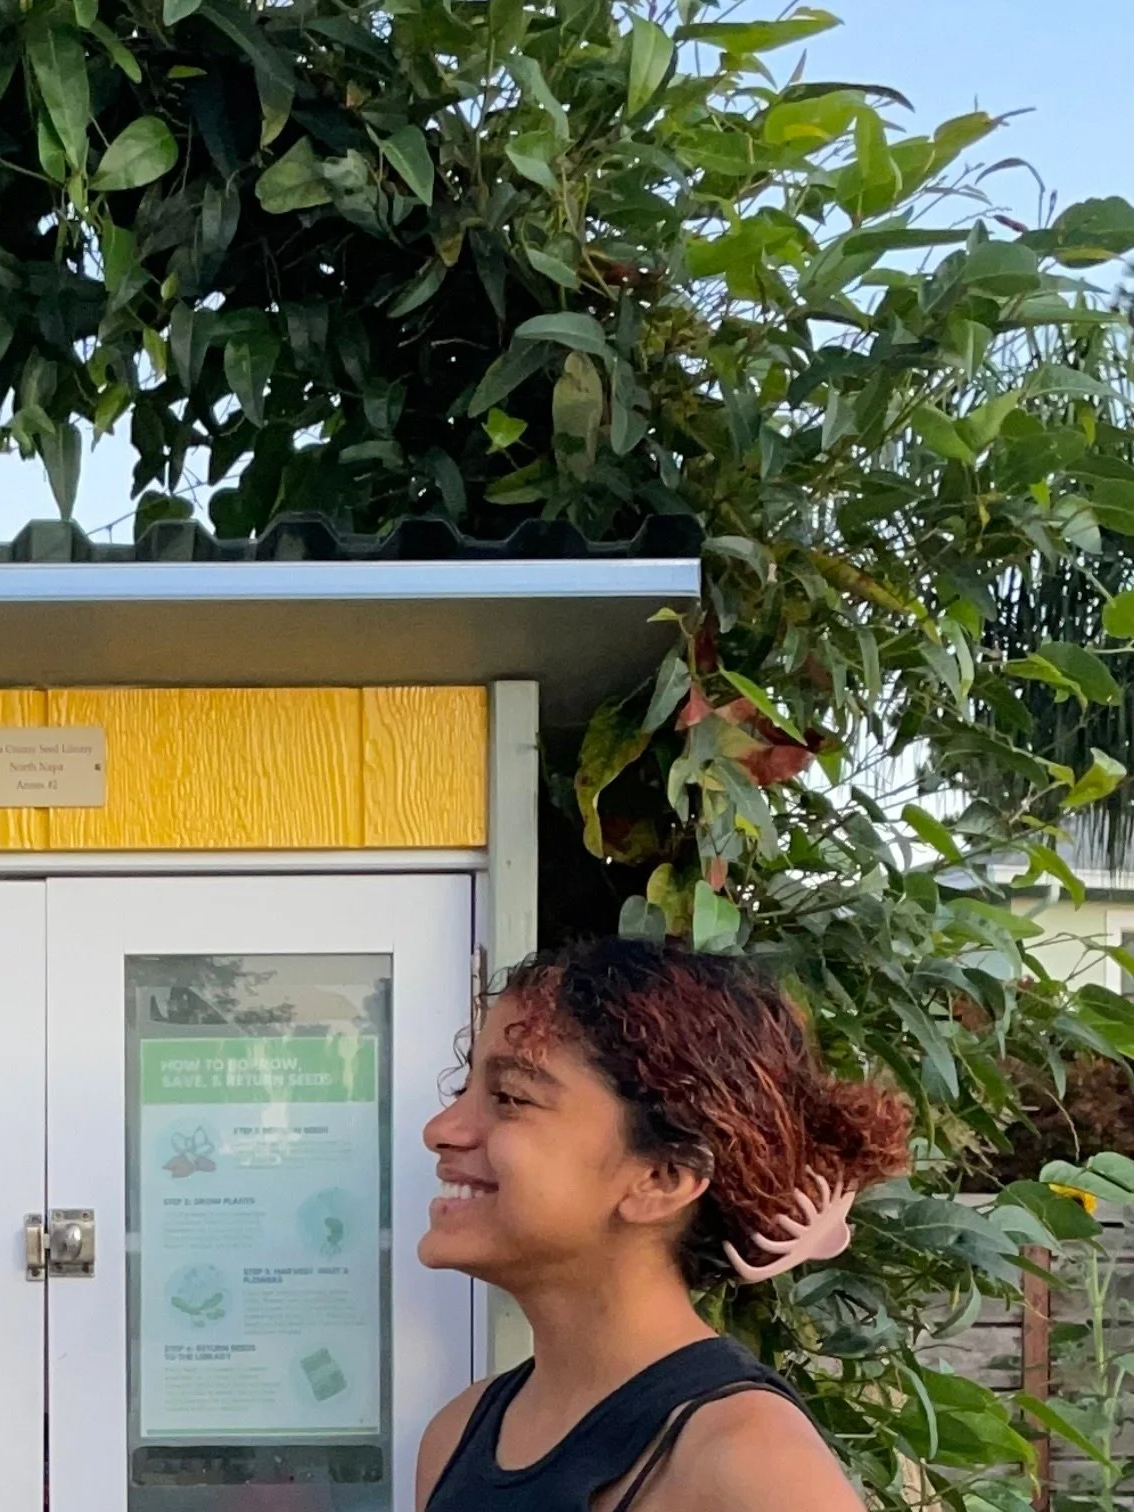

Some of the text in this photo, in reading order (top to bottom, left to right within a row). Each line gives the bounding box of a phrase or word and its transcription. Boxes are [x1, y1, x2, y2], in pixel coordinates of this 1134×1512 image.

[6, 744, 36, 755] County
[39, 744, 59, 754] Seed
[62, 744, 93, 756] Library
[9, 762, 64, 774] North Napa
[160, 1058, 302, 1071] HOW TO BOROW,
[162, 1073, 332, 1088] SAVE, & RETURN SEEDS
